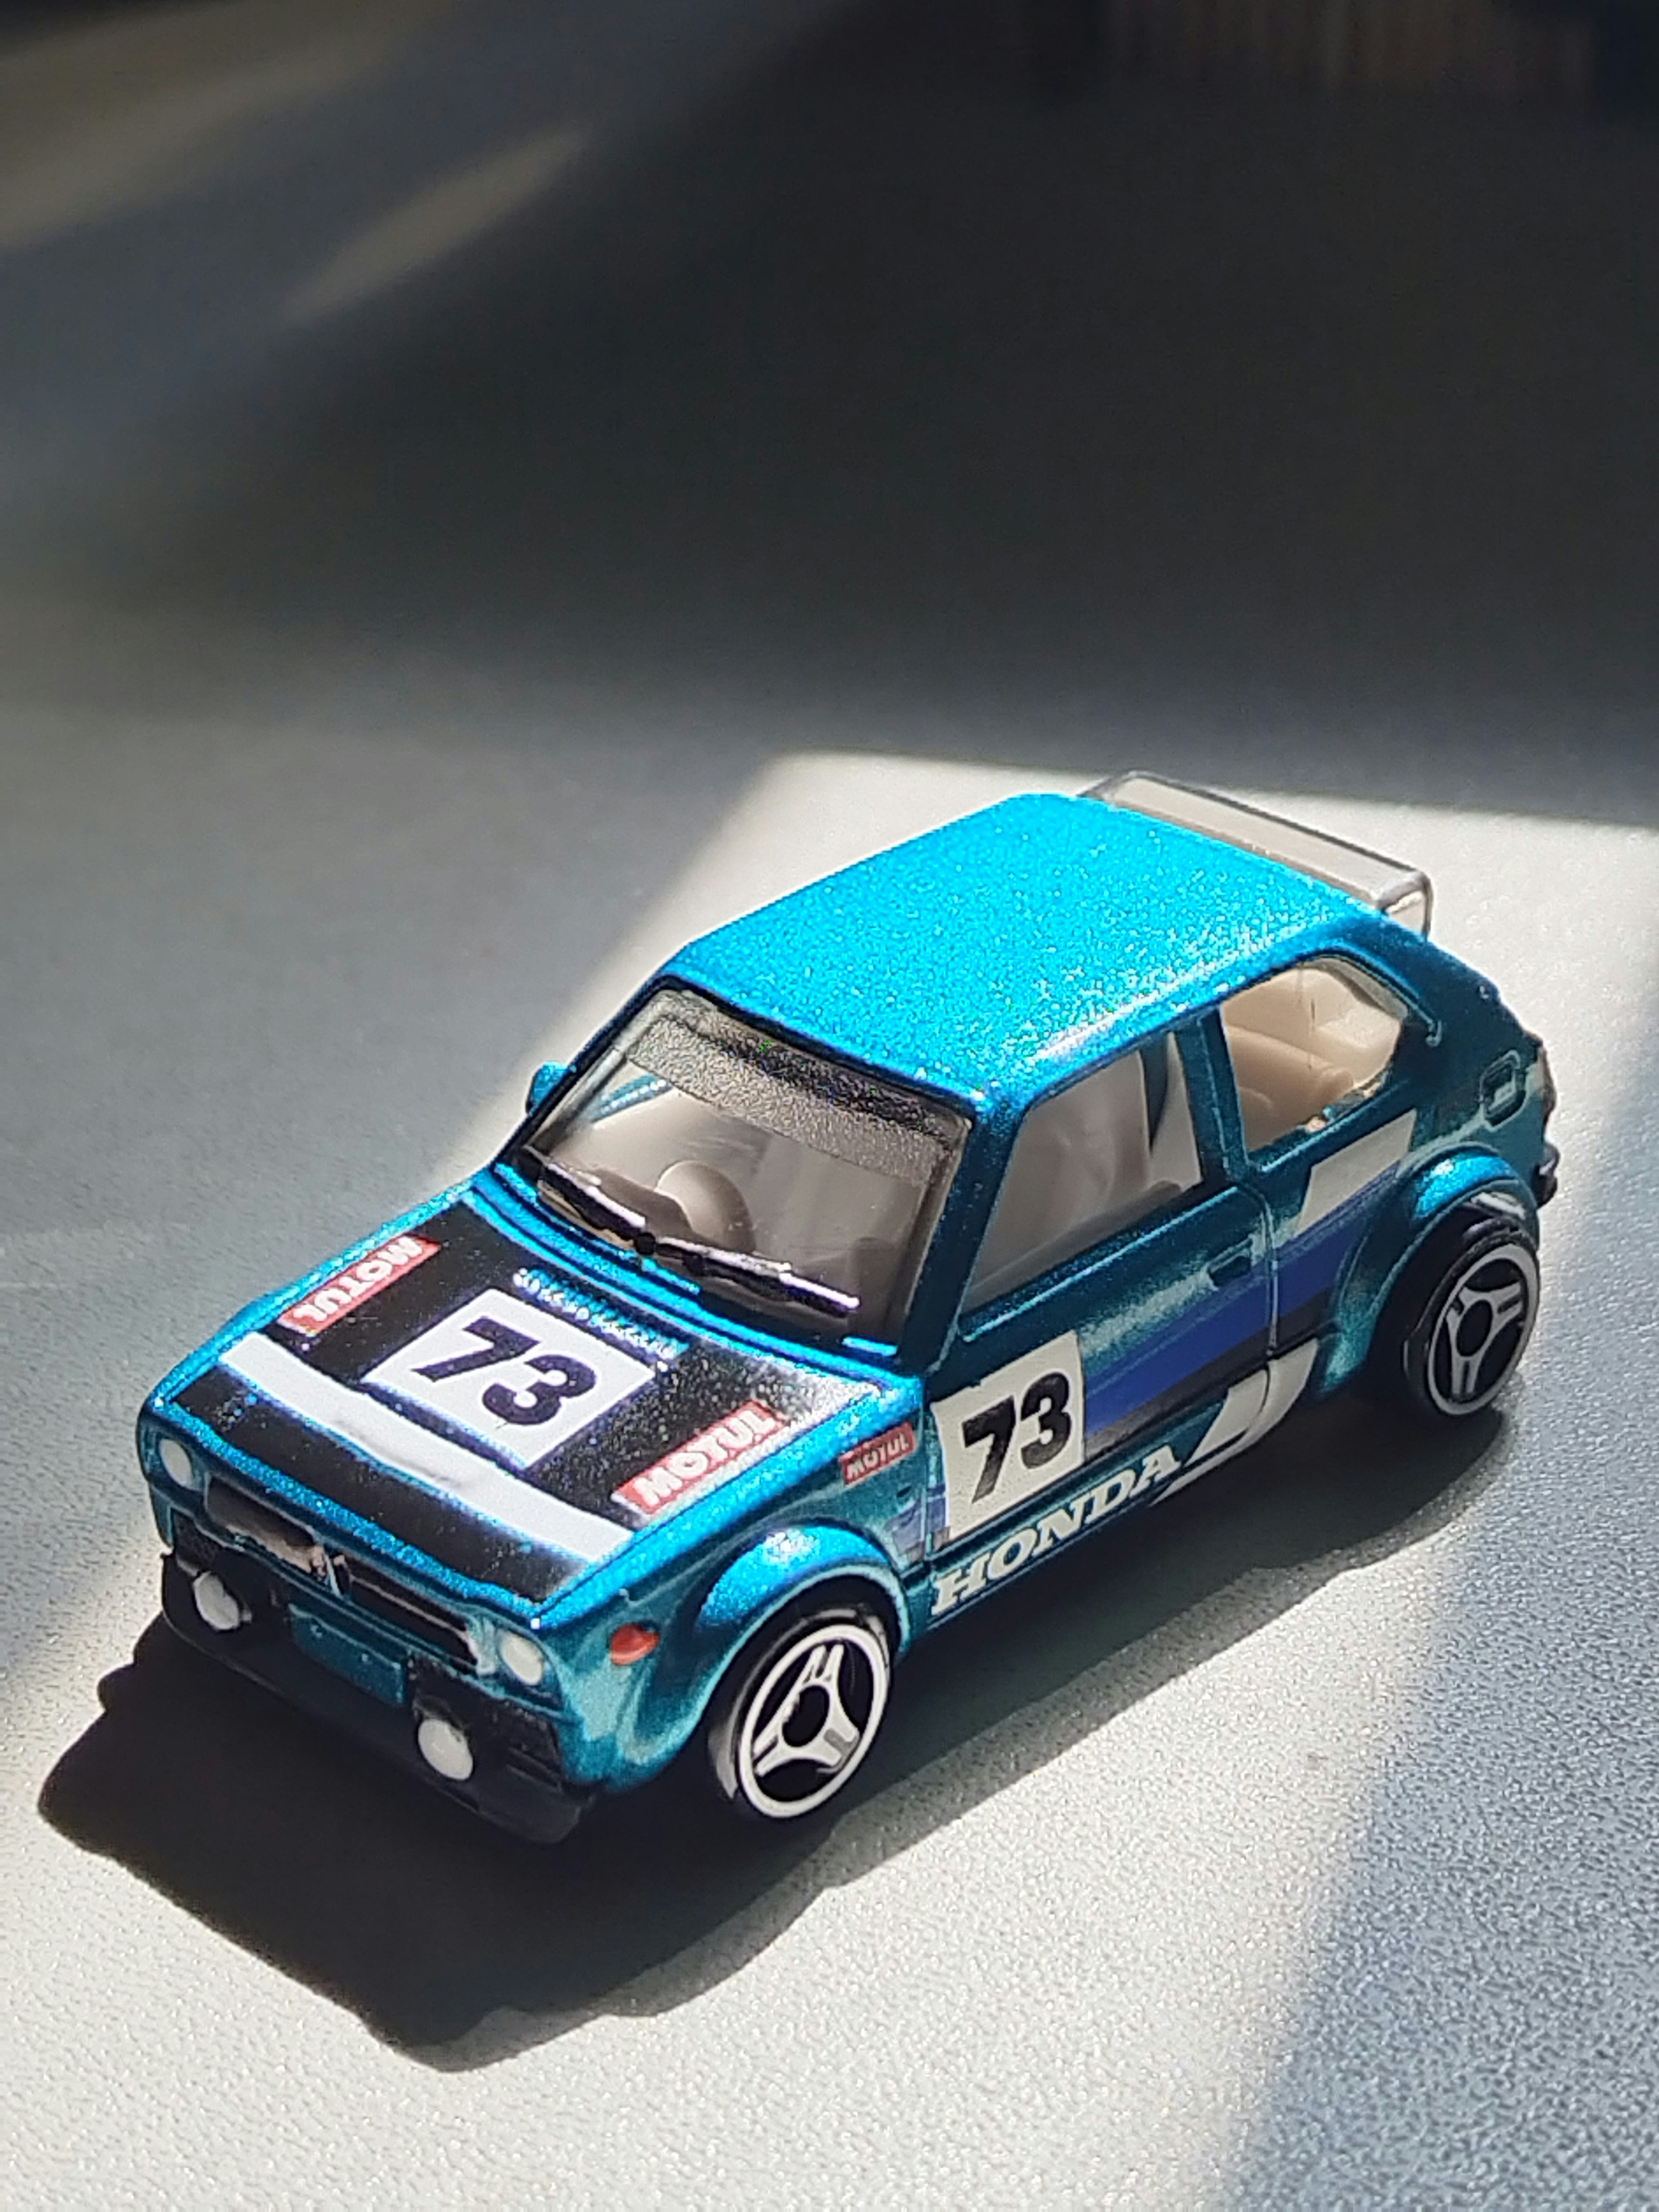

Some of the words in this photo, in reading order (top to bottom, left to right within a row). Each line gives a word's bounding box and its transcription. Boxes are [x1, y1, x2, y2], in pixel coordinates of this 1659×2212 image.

[294, 1236, 422, 1322] MOTUL
[411, 1315, 597, 1426] 73
[632, 1408, 775, 1506] MOTUL
[846, 1432, 909, 1480] MOTUL
[961, 1372, 1071, 1504] 73
[931, 1444, 1182, 1615] HONDA
